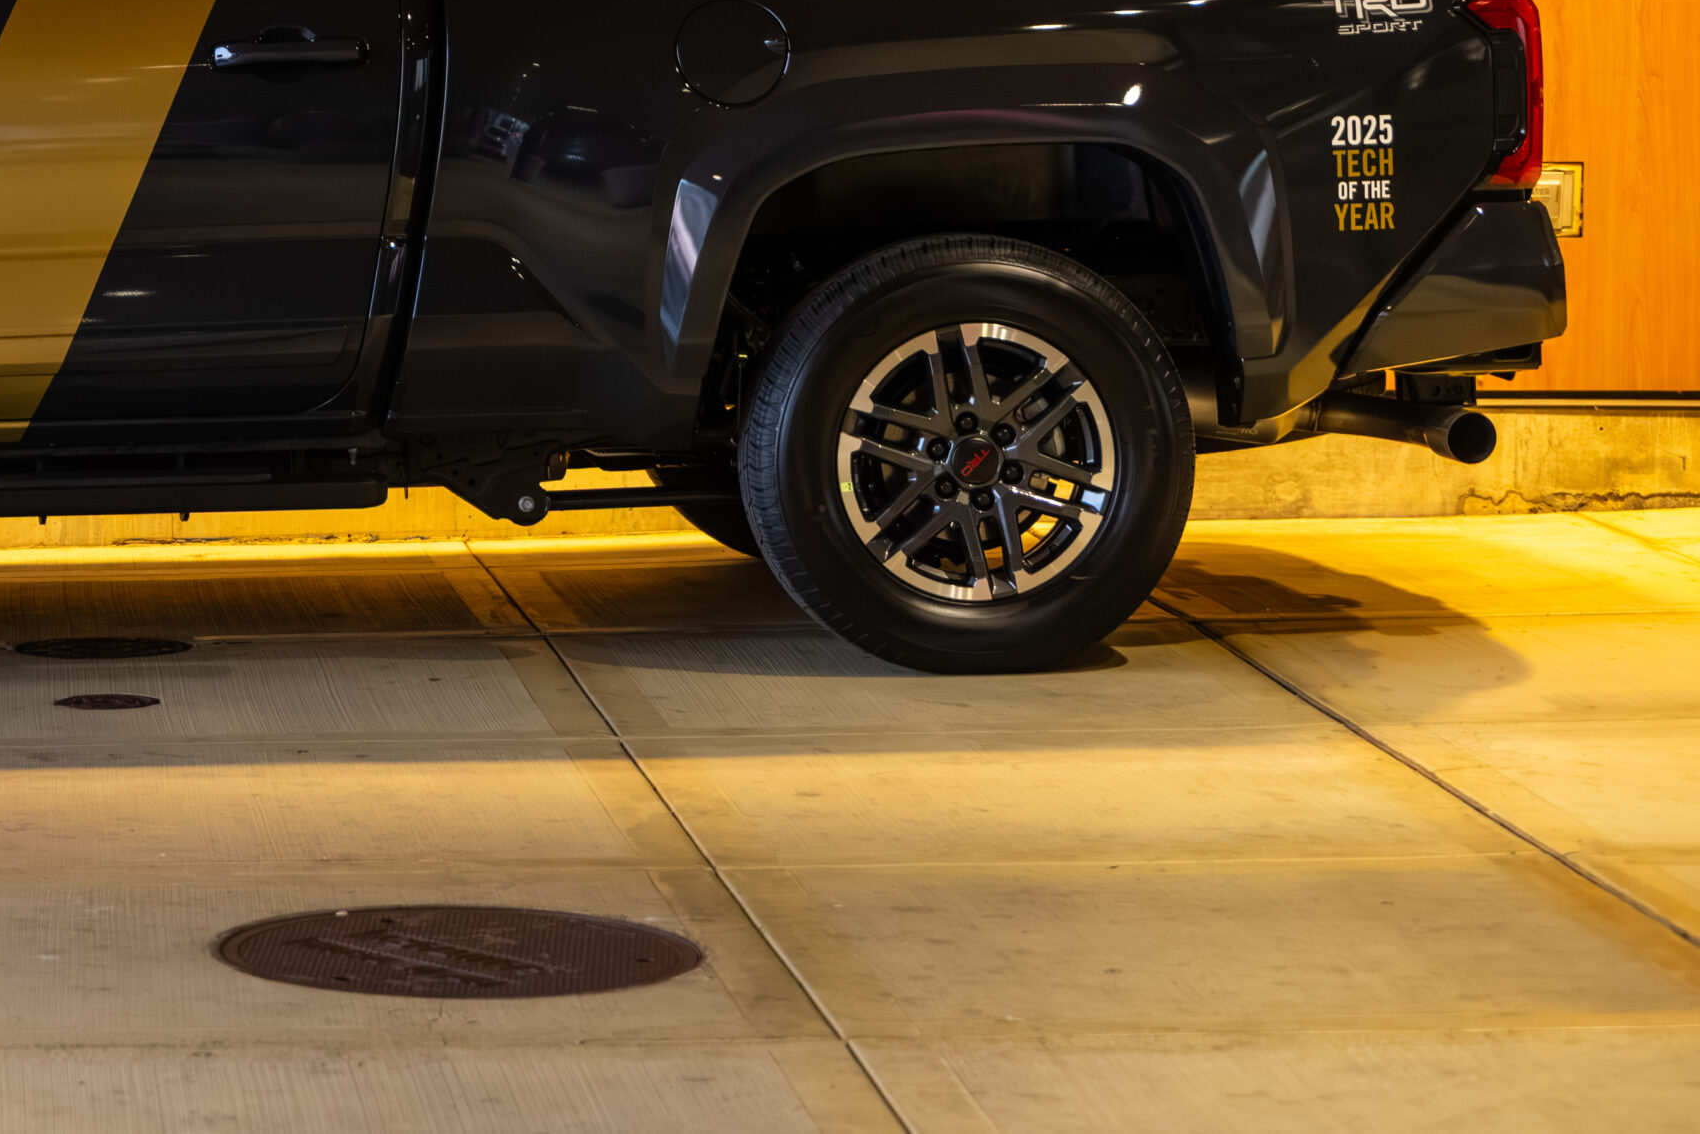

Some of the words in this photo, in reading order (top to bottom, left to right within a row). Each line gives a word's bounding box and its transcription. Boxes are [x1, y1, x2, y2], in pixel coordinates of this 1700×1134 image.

[1337, 19, 1423, 35] SPORT
[1330, 114, 1394, 147] 2025
[1332, 147, 1395, 178] TECH
[1337, 181, 1358, 201] OF
[1362, 179, 1391, 199] THE
[1334, 201, 1396, 232] YEAR
[960, 449, 991, 477] TRD
